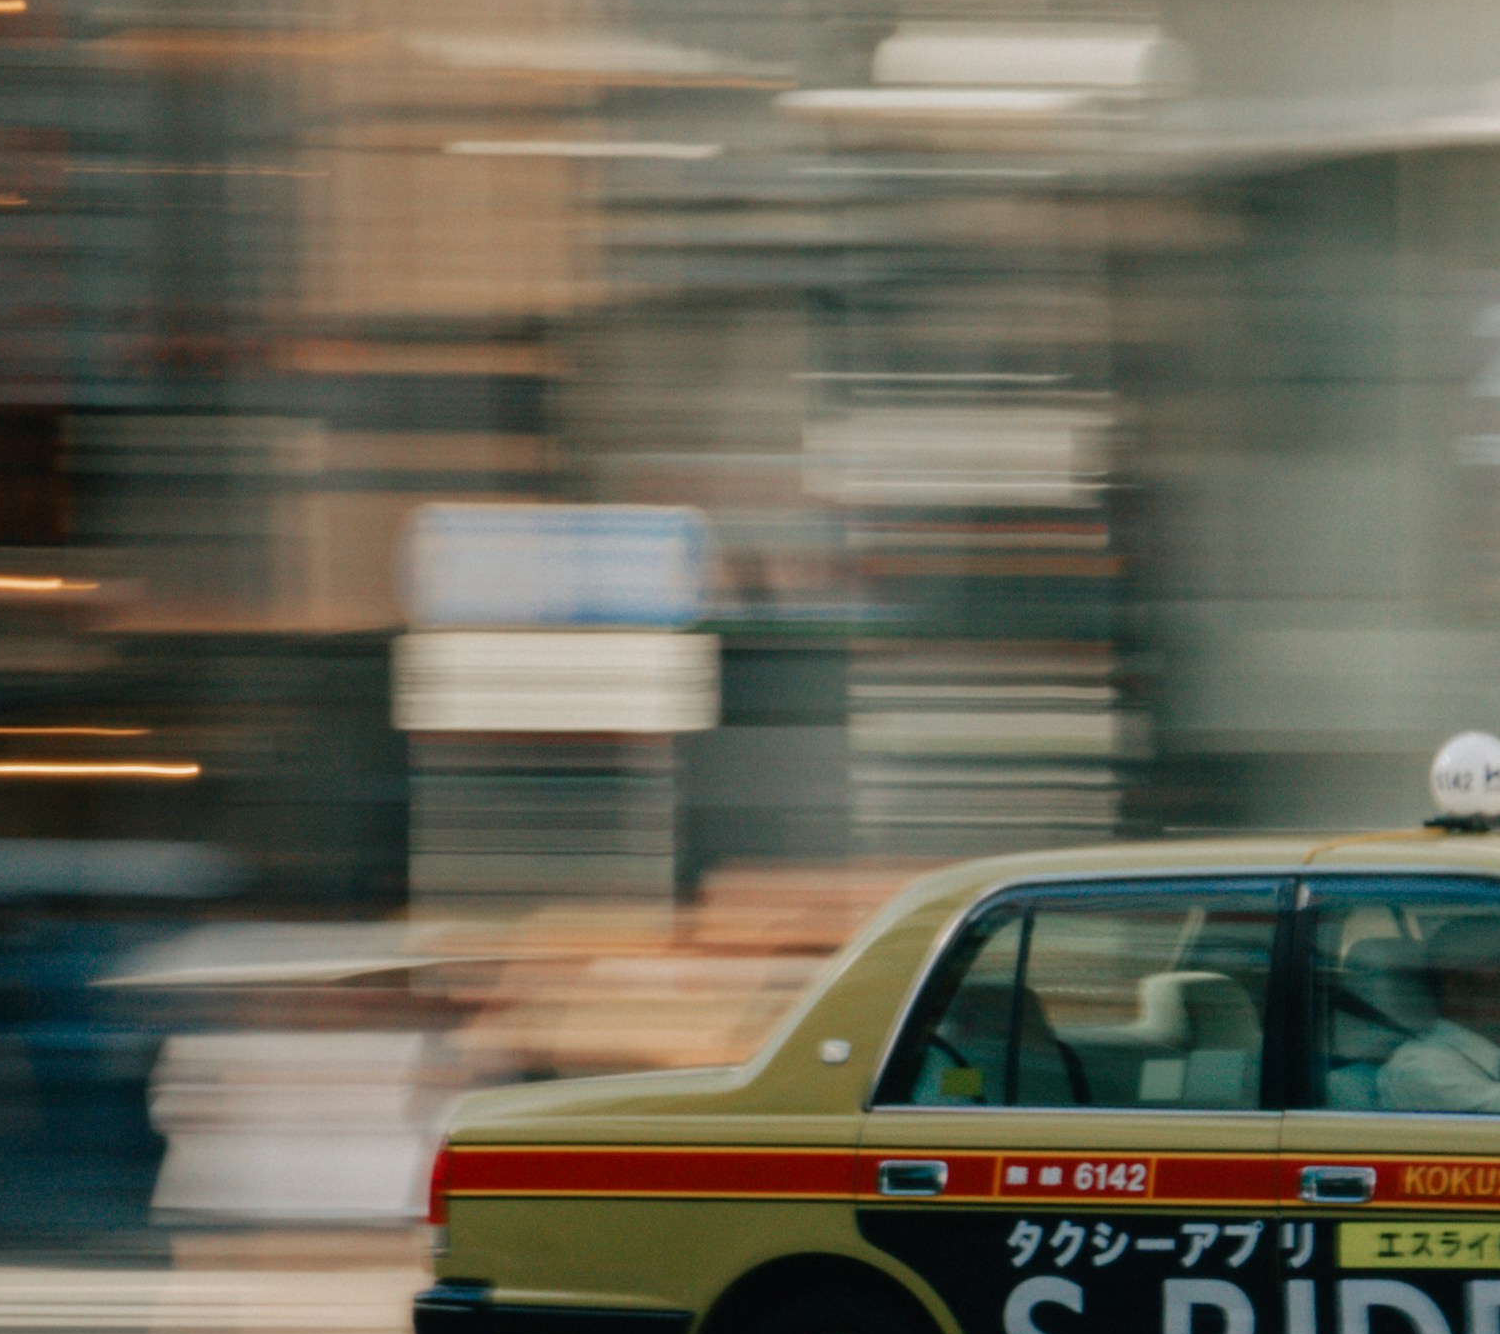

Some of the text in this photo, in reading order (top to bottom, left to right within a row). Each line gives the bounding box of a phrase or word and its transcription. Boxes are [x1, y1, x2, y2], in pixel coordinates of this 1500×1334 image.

[1073, 1161, 1147, 1191] 6142
[1007, 1219, 1315, 1268] タクシーアプリ
